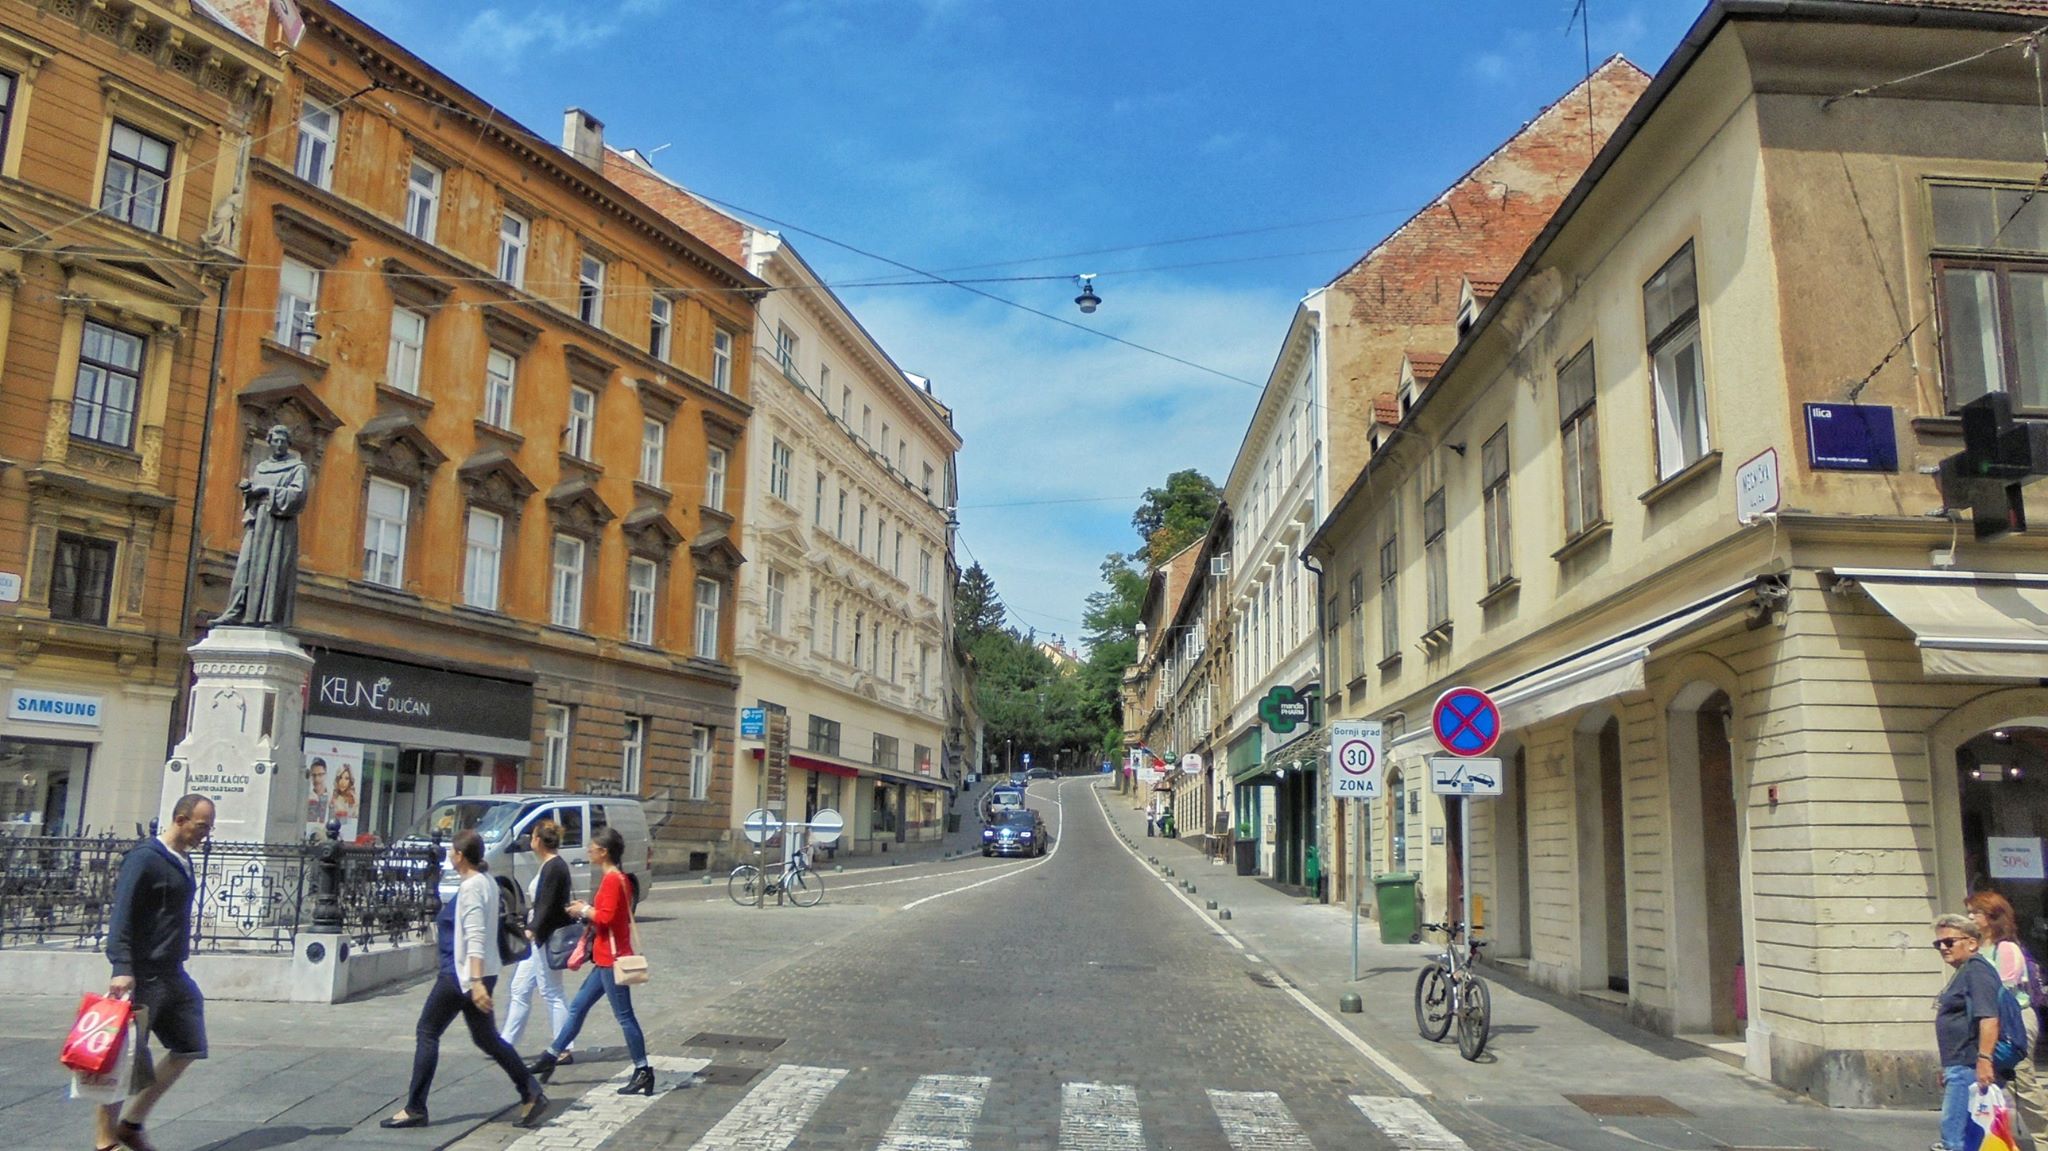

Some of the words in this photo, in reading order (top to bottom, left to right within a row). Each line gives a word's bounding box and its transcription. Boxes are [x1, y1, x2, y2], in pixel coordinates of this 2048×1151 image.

[1812, 407, 1832, 418] Ilica
[320, 675, 384, 710] KEUNE
[17, 697, 96, 717] SAMSUNG
[1334, 727, 1359, 737] Gornji
[1361, 728, 1380, 737] grad
[1347, 749, 1367, 766] 30
[1340, 780, 1374, 791] ZONA
